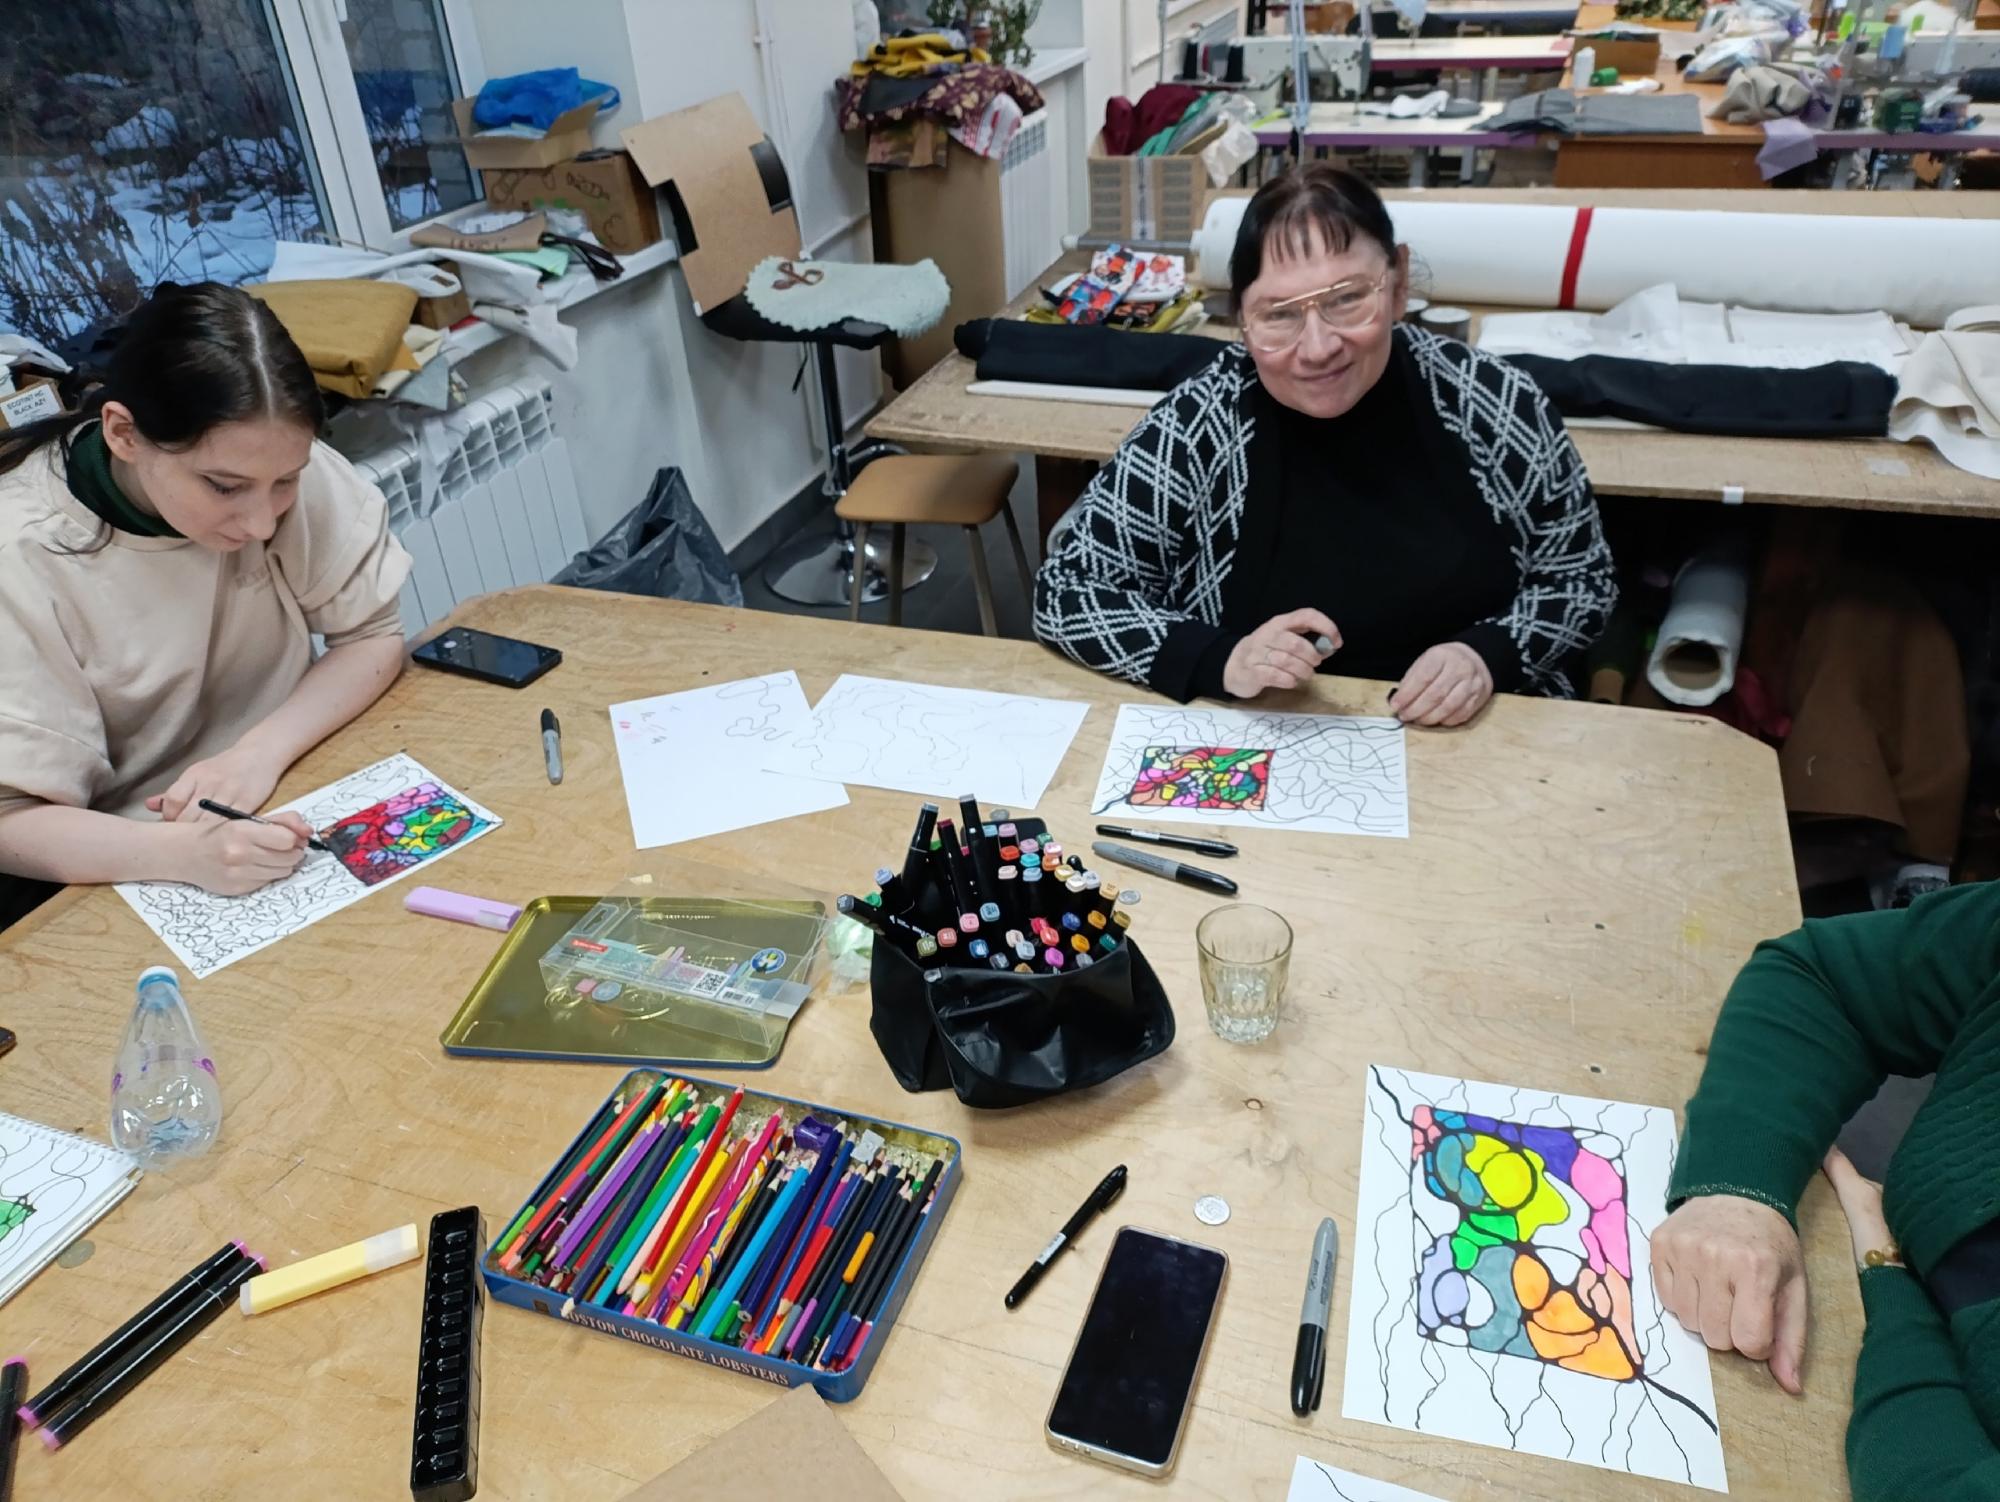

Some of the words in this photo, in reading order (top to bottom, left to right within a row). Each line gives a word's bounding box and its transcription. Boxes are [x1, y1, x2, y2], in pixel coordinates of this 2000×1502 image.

[13, 404, 32, 416] BLACK
[564, 1309, 617, 1334] OSTON
[621, 1326, 707, 1361] CHOCOLATE
[710, 1353, 789, 1386] LOBSTERS
